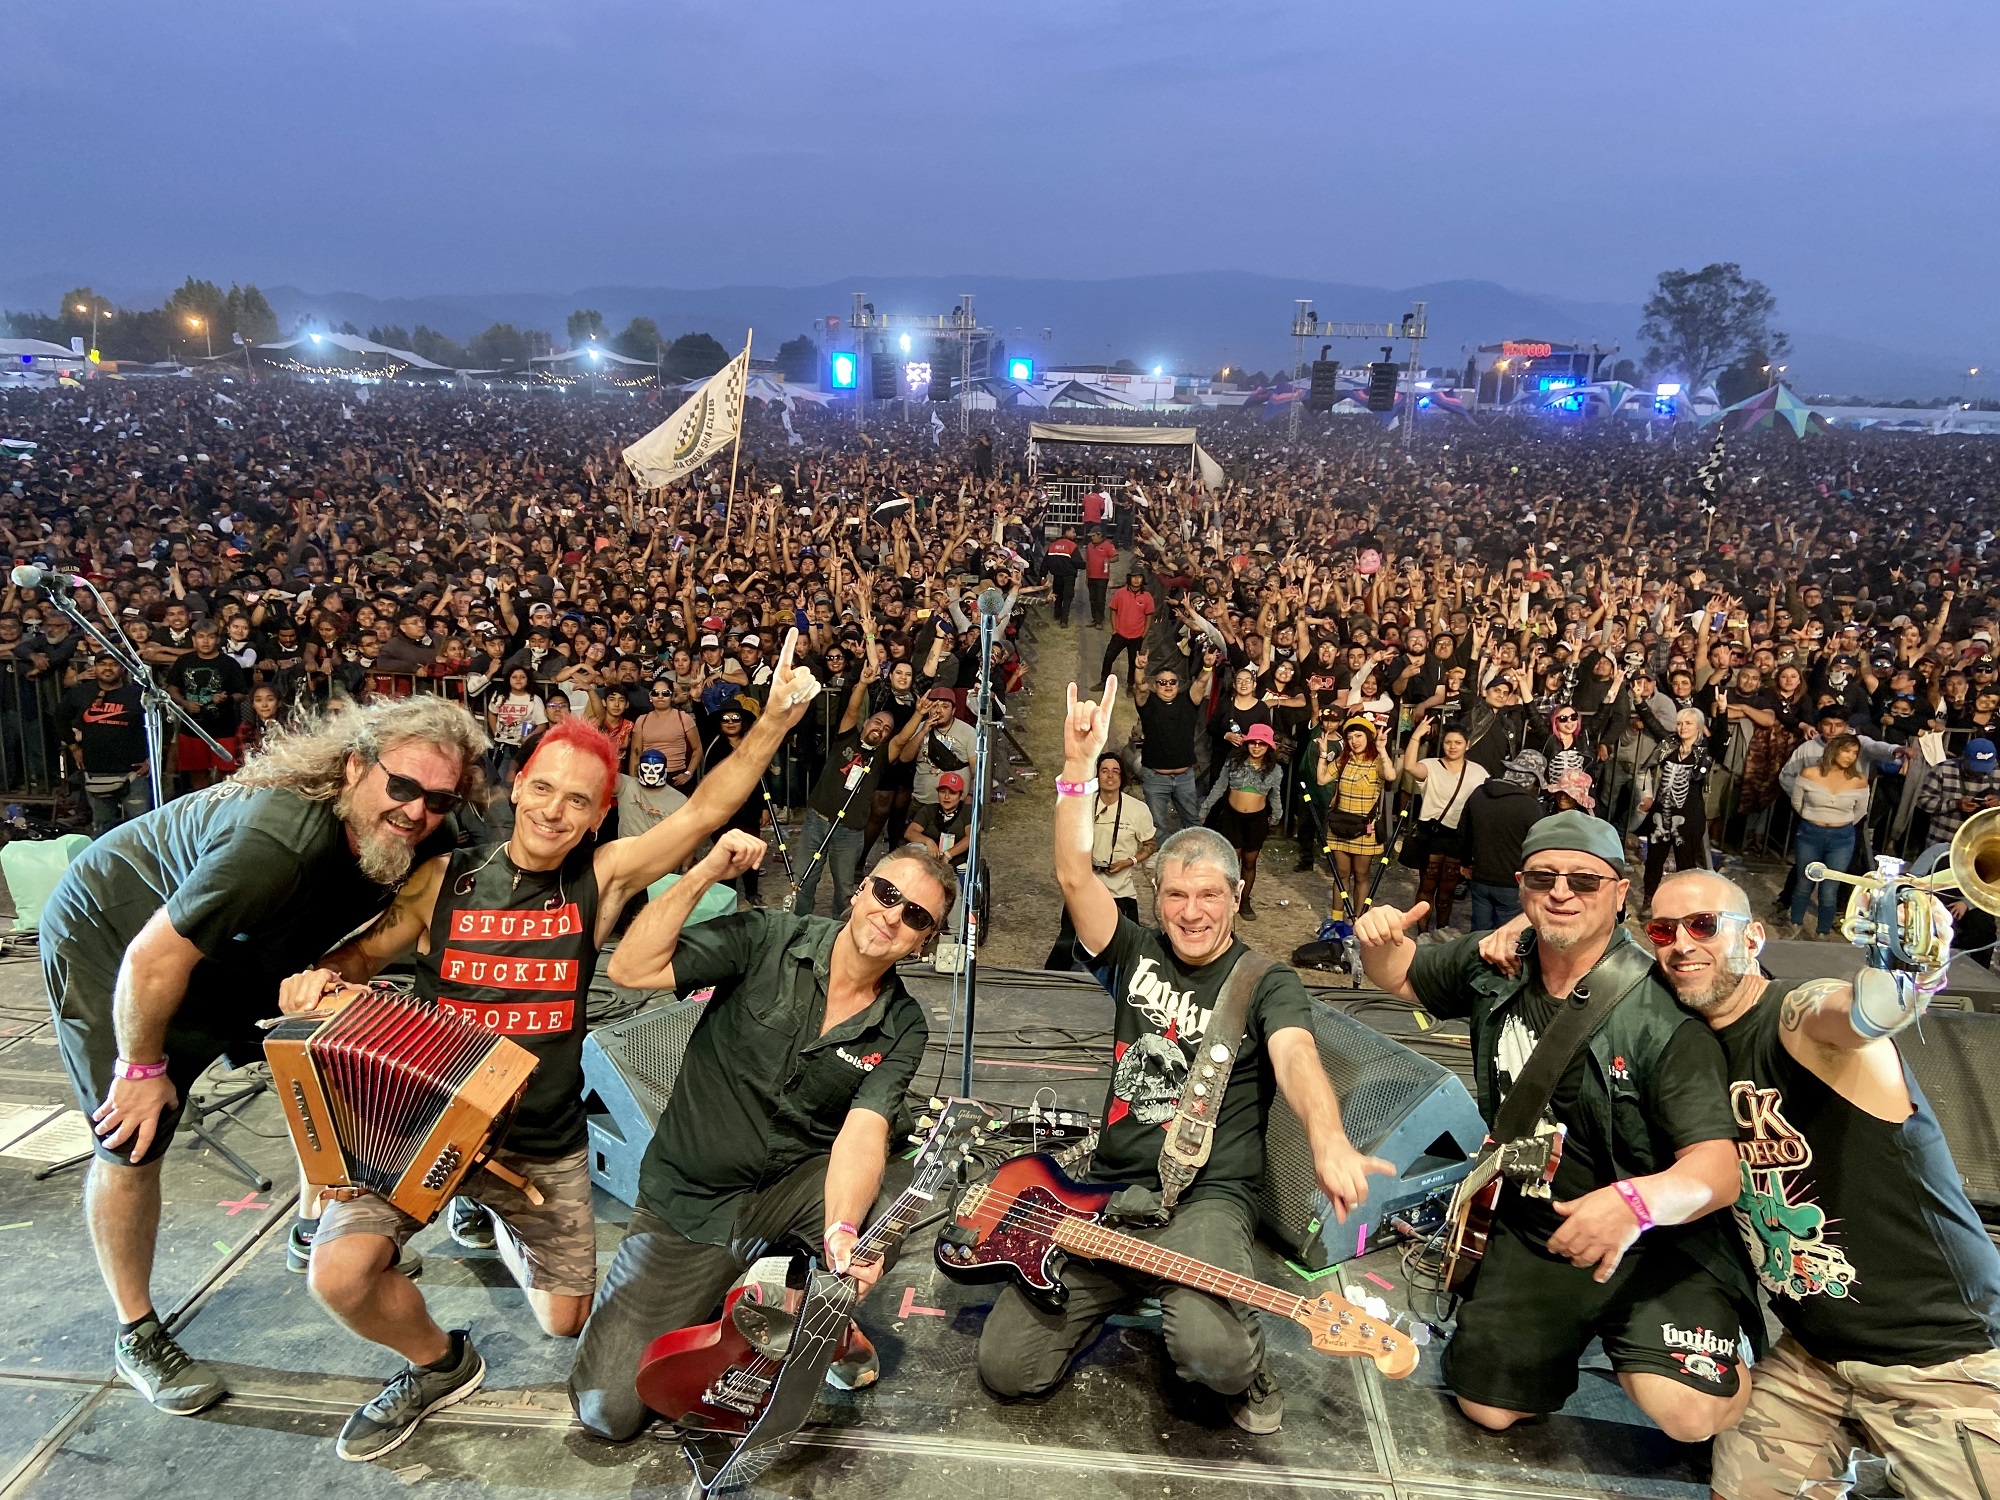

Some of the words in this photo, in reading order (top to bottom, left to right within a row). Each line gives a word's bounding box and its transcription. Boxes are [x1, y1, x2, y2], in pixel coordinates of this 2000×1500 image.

[706, 398, 715, 429] CLUB
[700, 431, 713, 449] SKA
[685, 448, 705, 467] CREW
[90, 702, 124, 713] STAN
[498, 706, 526, 714] SKA-P
[459, 915, 571, 937] STUPID
[449, 960, 568, 982] FUCKIN
[444, 1004, 563, 1030] PEOPLE
[957, 1109, 983, 1122] Gibson
[1730, 1081, 1799, 1140] CK
[1737, 1139, 1807, 1165] DERO
